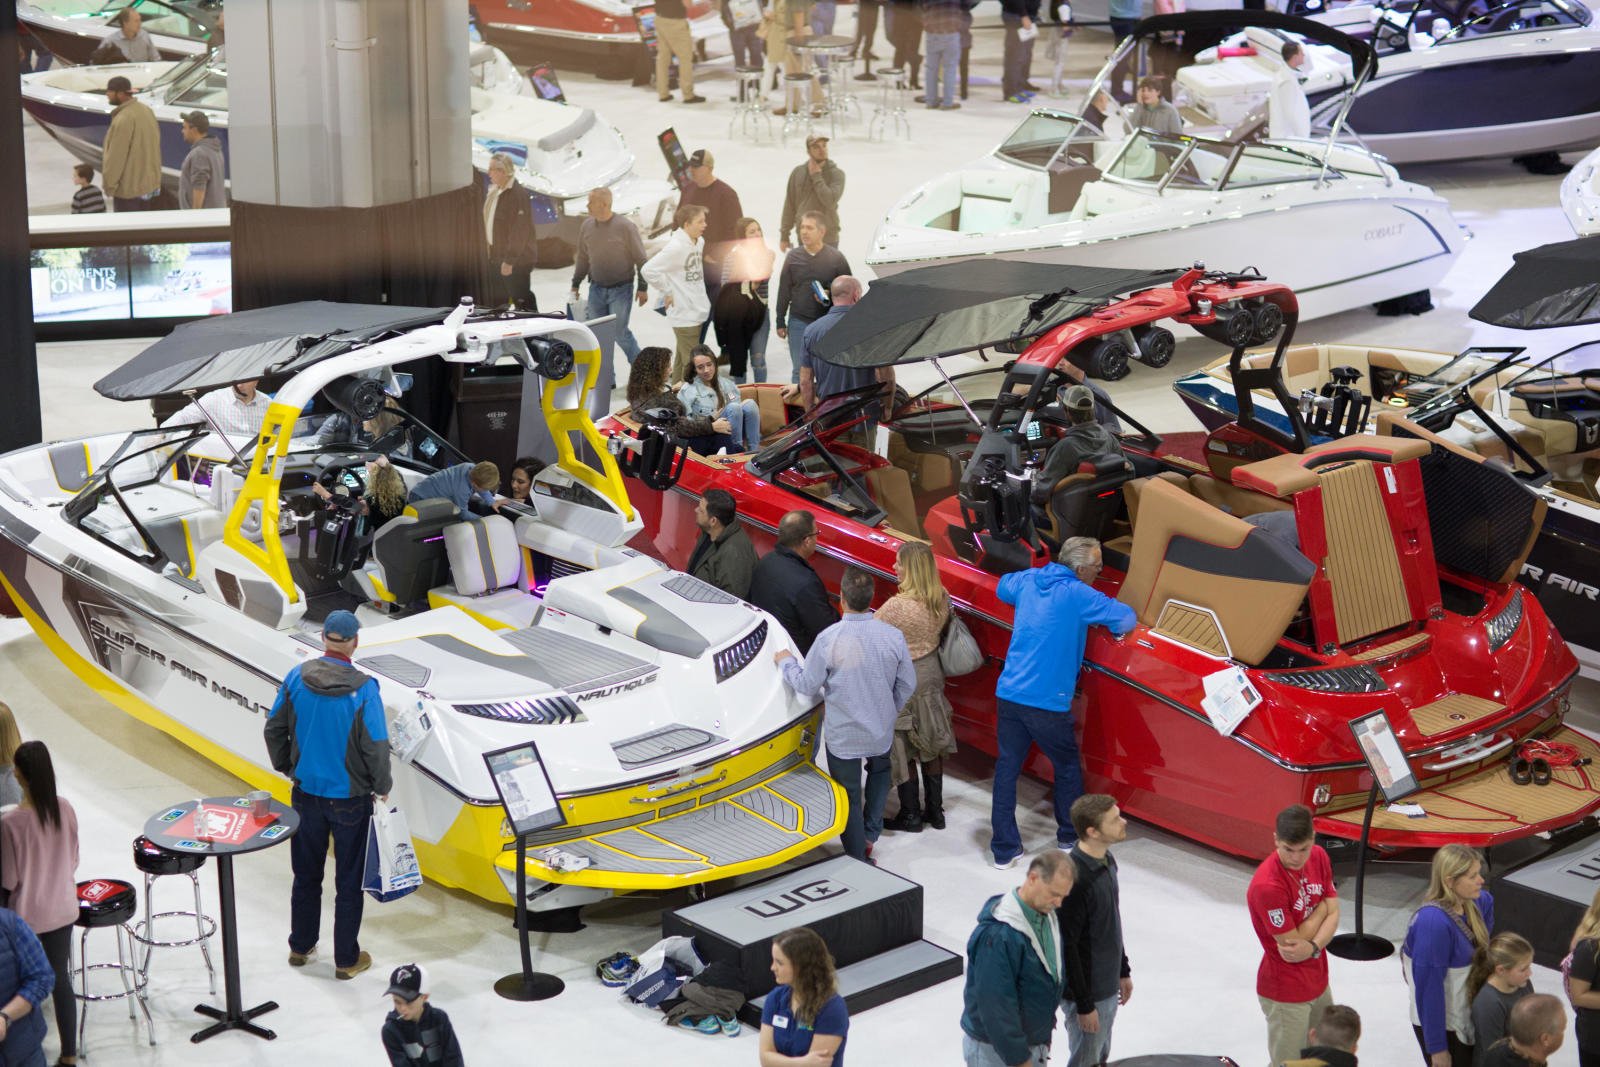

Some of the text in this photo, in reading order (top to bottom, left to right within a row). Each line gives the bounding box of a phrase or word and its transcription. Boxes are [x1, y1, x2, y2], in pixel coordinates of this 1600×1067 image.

[51, 266, 117, 280] PAYMENTS
[51, 277, 117, 294] ON US
[1546, 572, 1600, 601] AIR
[90, 617, 271, 719] SUPER AIR NAUT
[576, 673, 657, 702] NAUTIQUE
